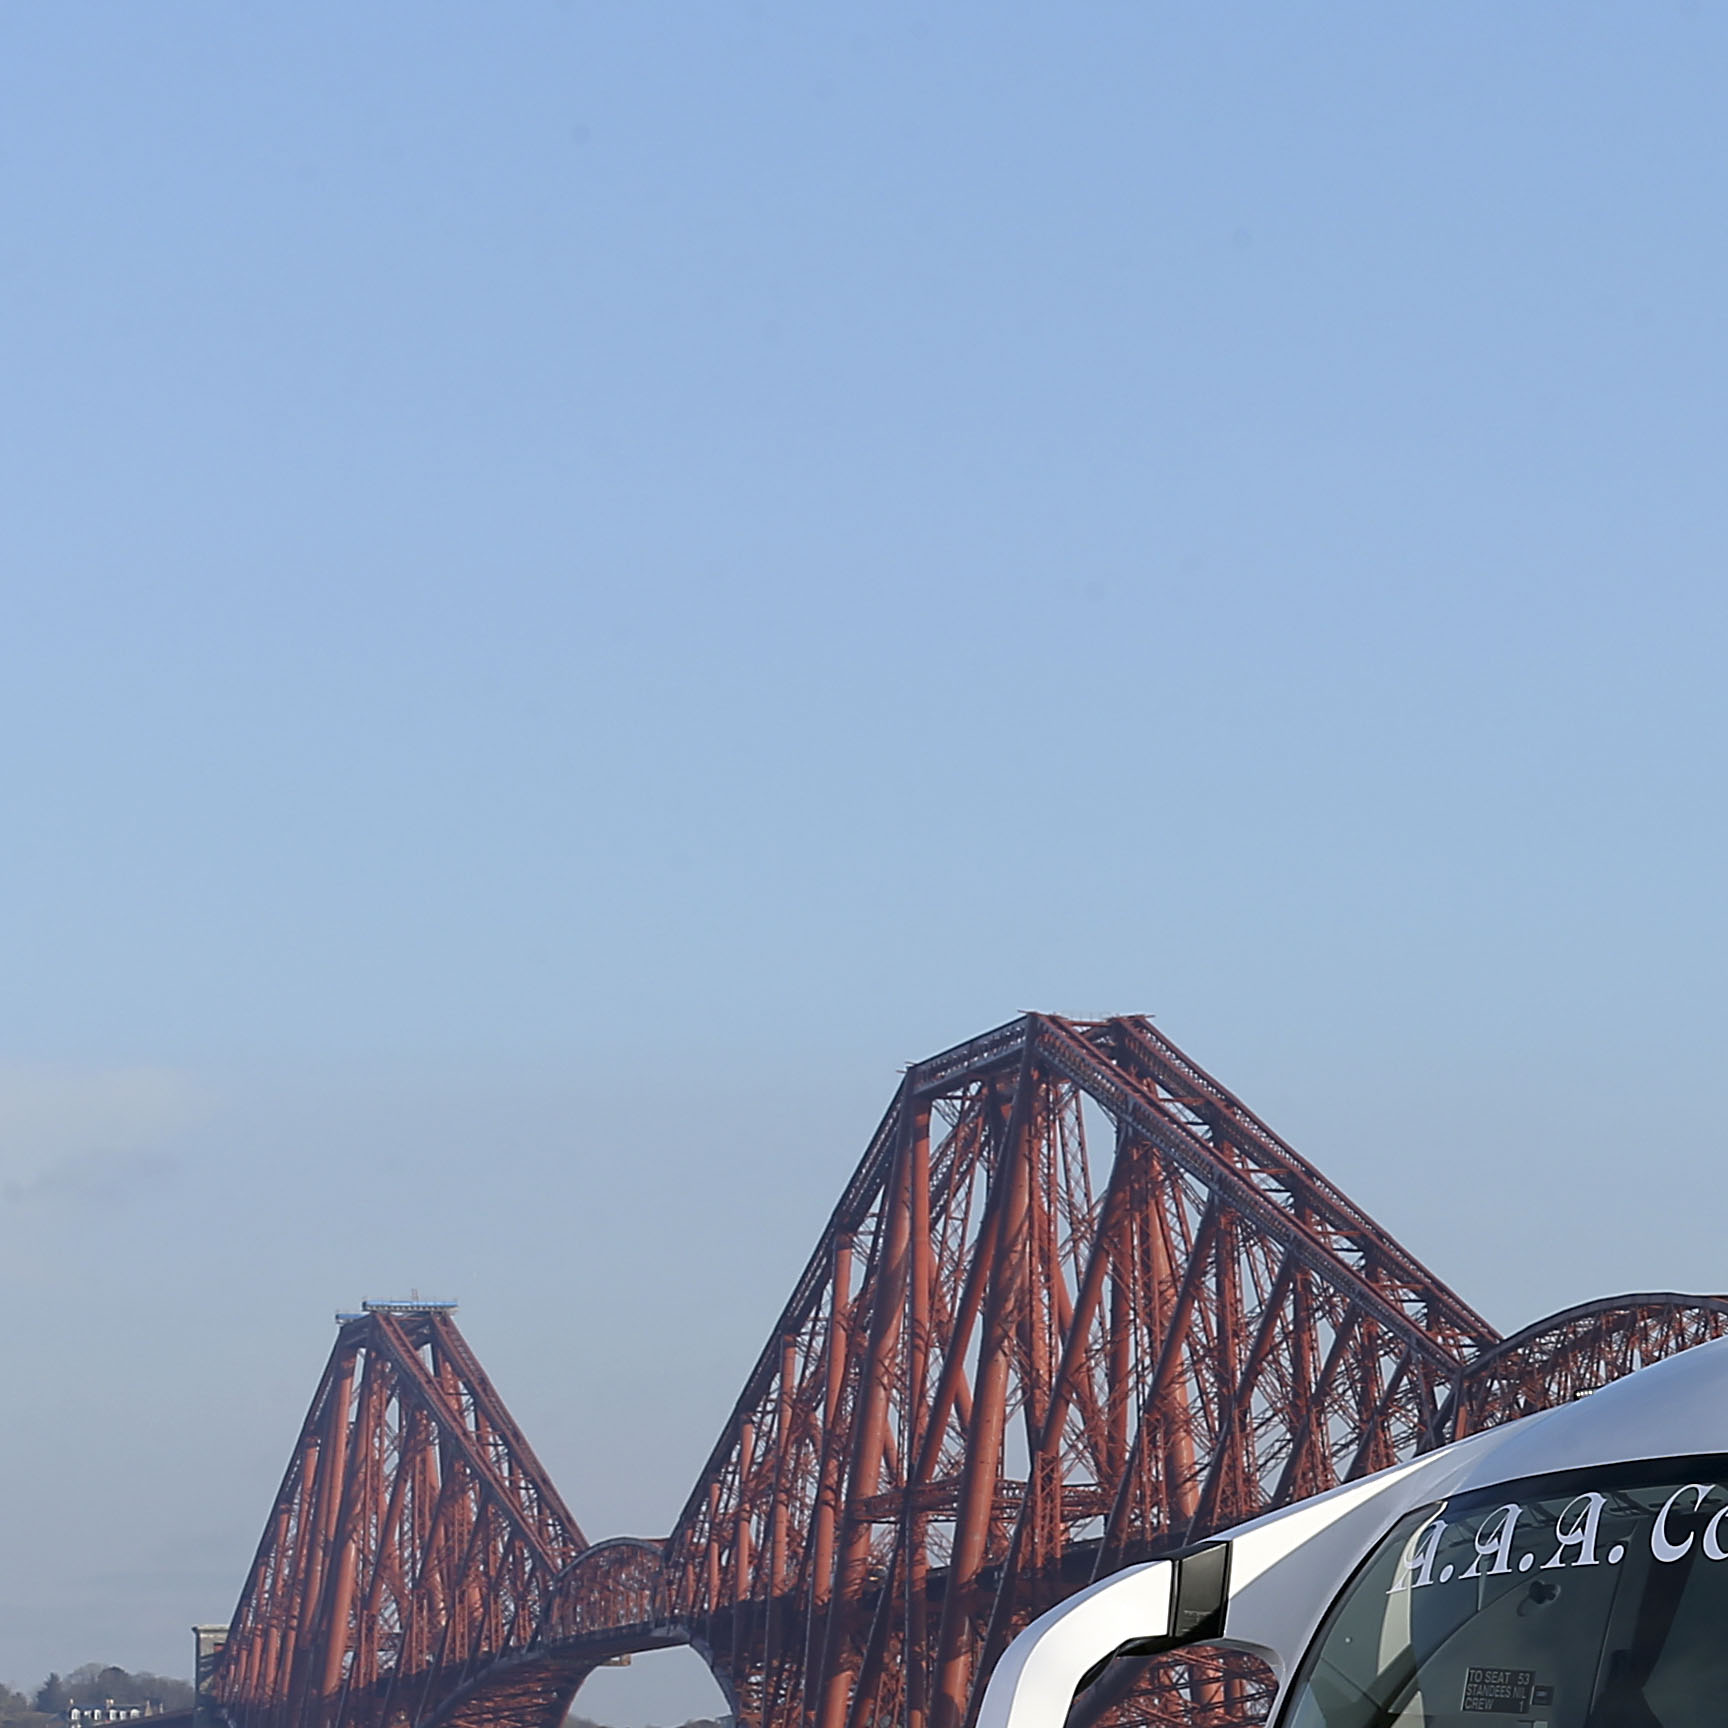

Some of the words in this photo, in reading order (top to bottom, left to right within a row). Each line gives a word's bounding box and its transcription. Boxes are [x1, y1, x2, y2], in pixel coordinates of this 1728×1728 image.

[1386, 1490, 1625, 1594] A.A.A.
[1469, 1669, 1483, 1682] TO
[1485, 1671, 1511, 1684] SEAT
[1517, 1672, 1530, 1685] 53
[1466, 1683, 1512, 1699] STANDEES
[1513, 1686, 1527, 1699] NIL
[1464, 1697, 1495, 1710] CREW
